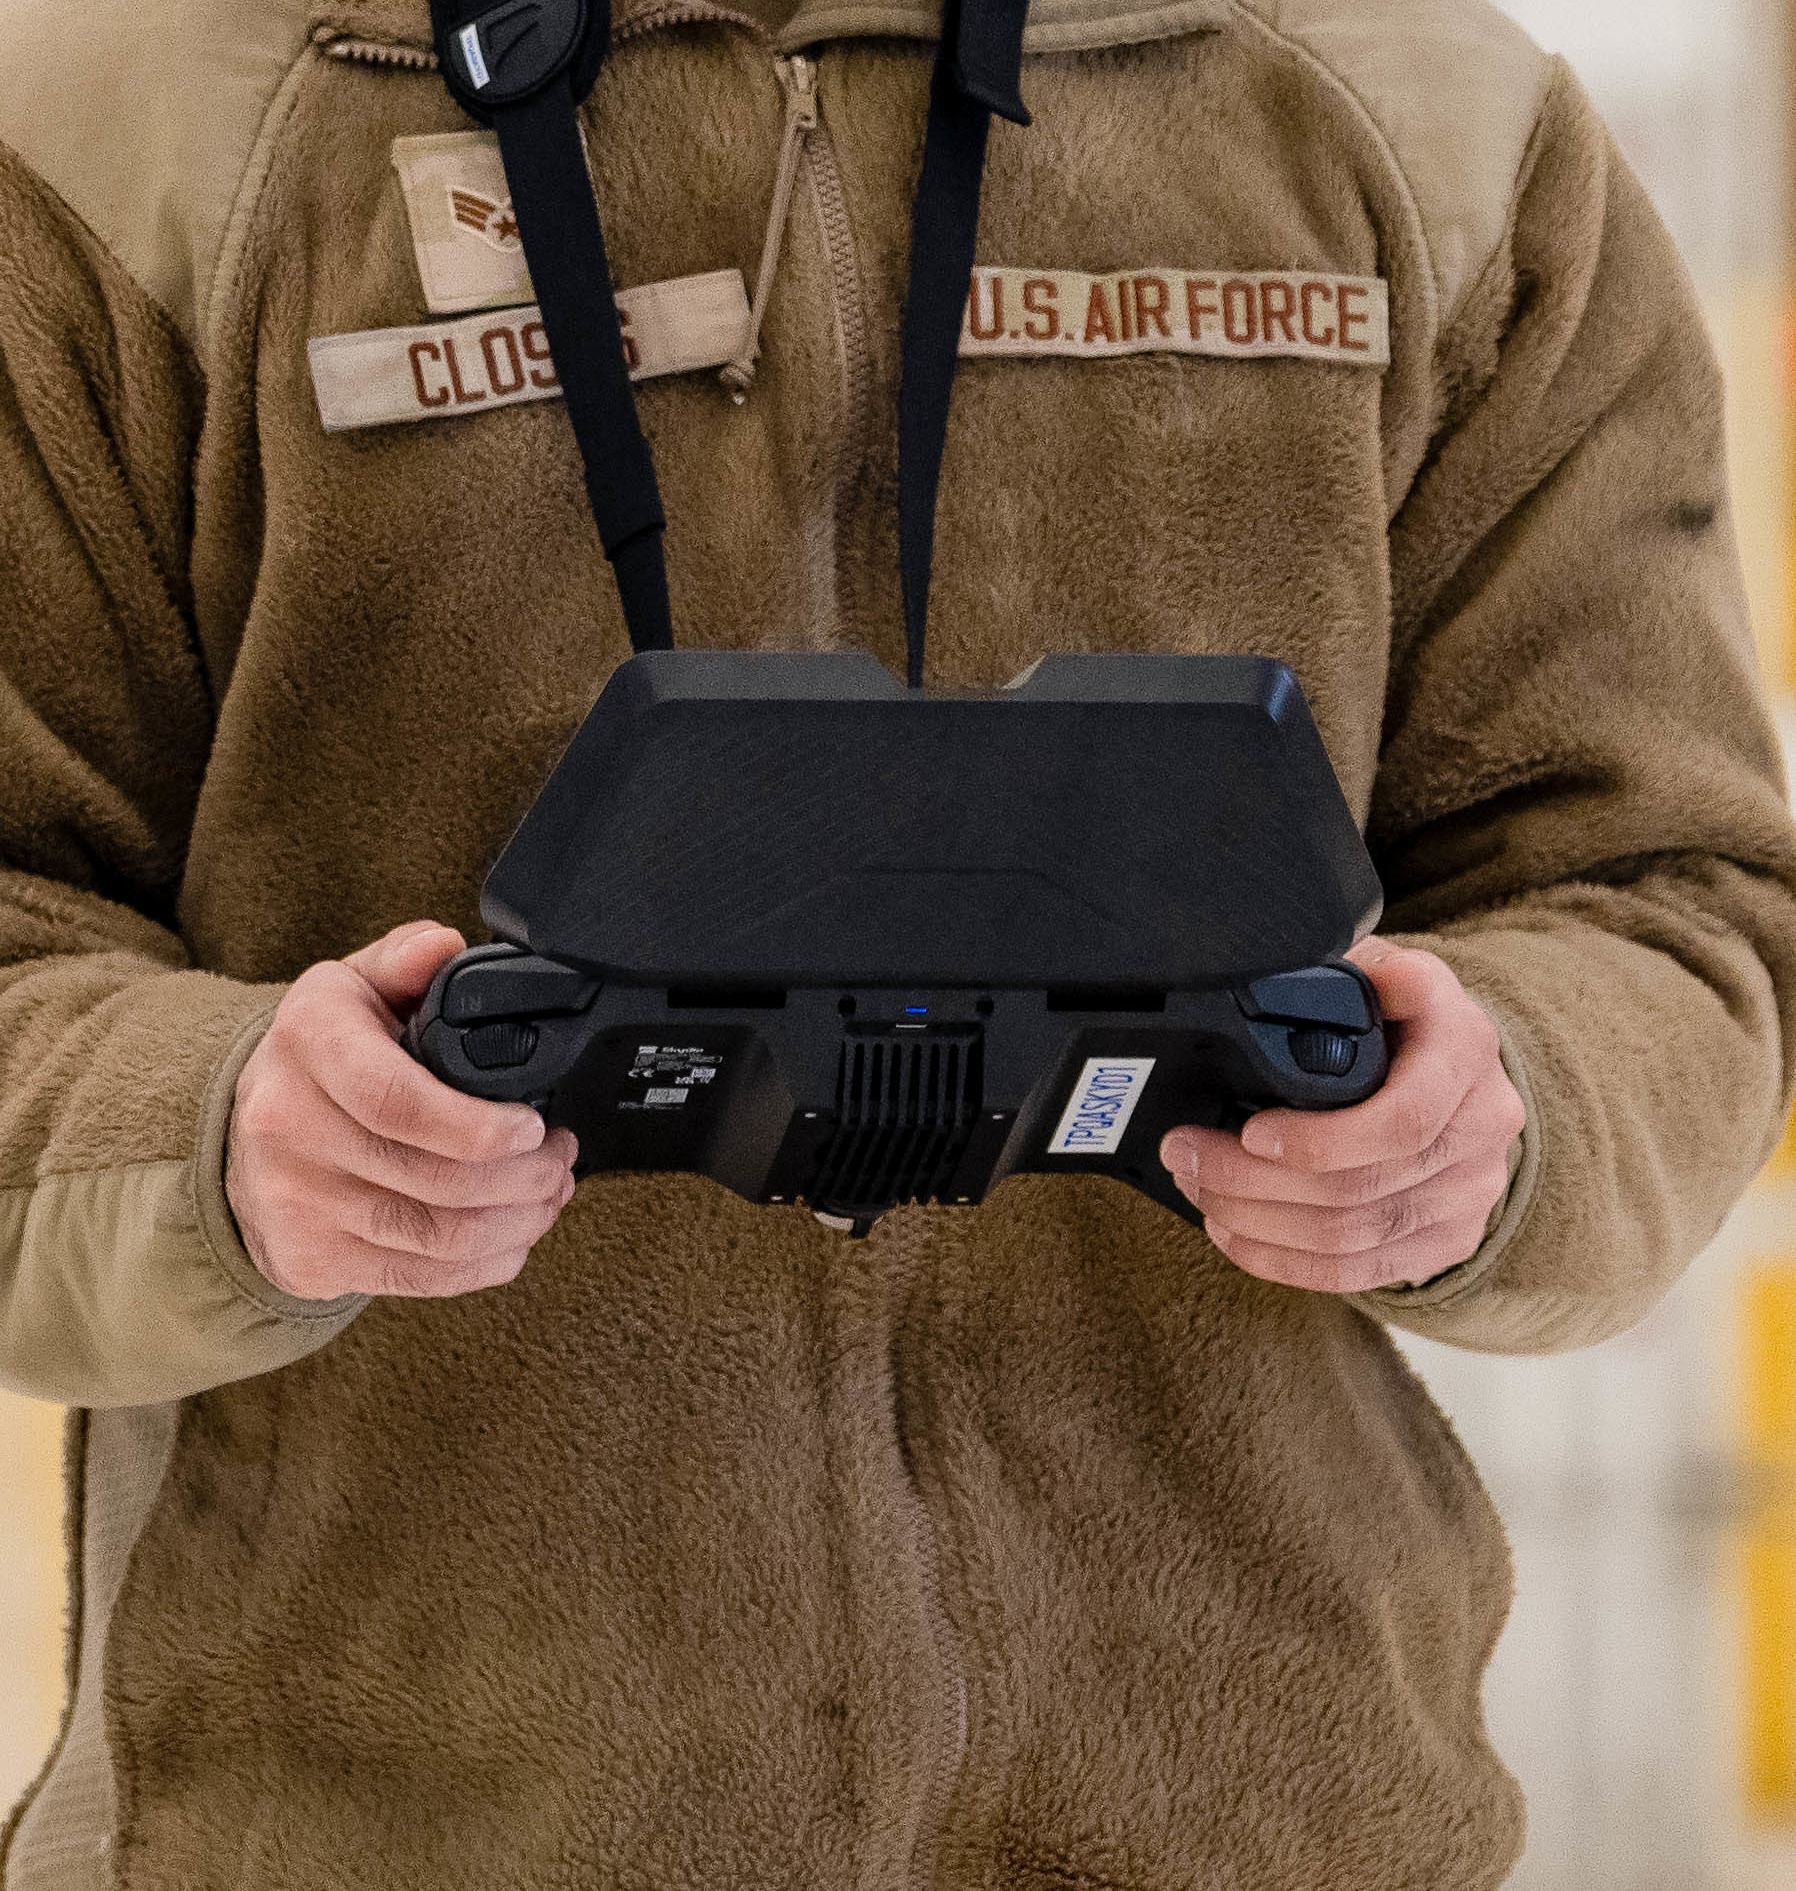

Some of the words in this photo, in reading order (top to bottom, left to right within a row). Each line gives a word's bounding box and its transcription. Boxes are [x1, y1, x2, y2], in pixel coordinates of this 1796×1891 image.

[969, 276, 1074, 342] U.S.
[1083, 276, 1172, 343] AIR
[1185, 279, 1370, 351] FORCE
[409, 309, 641, 407] CLOS
